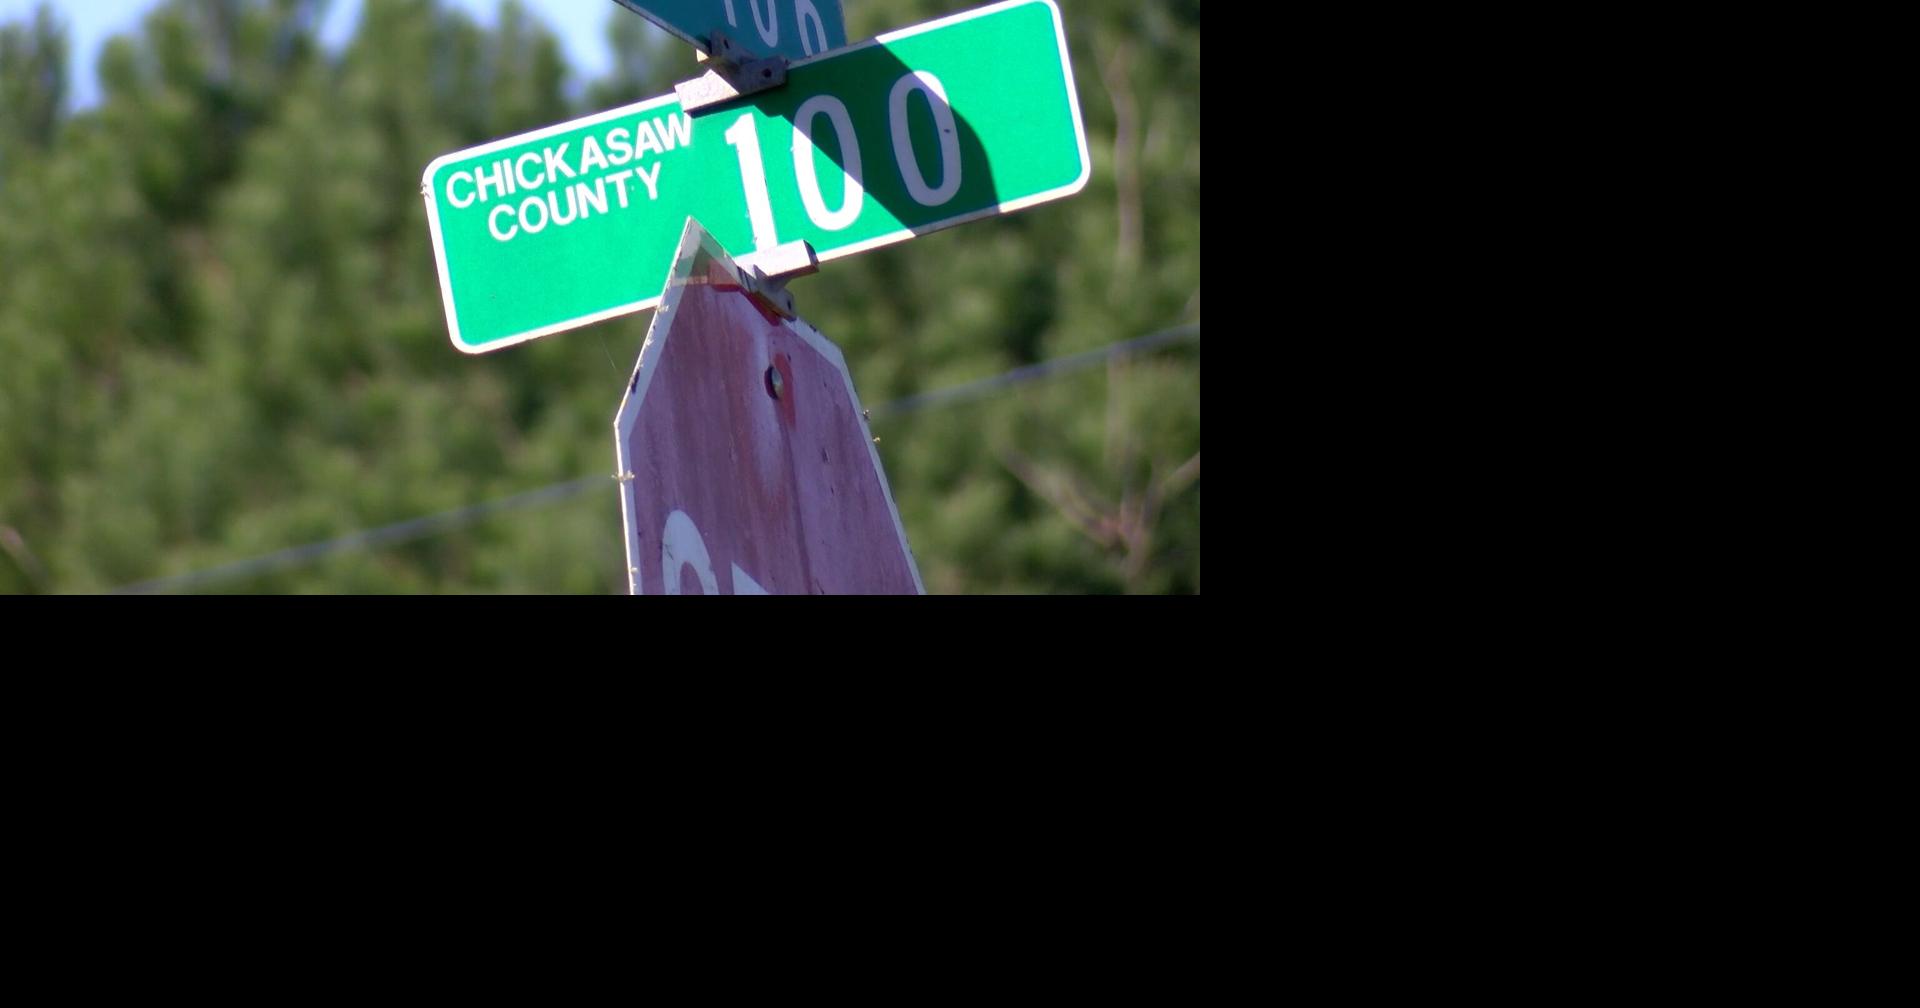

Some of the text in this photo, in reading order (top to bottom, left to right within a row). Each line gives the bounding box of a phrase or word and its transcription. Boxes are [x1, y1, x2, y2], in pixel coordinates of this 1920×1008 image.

[446, 112, 692, 208] CHICKASAW
[488, 161, 661, 241] COUNTY
[725, 70, 962, 251] 100
